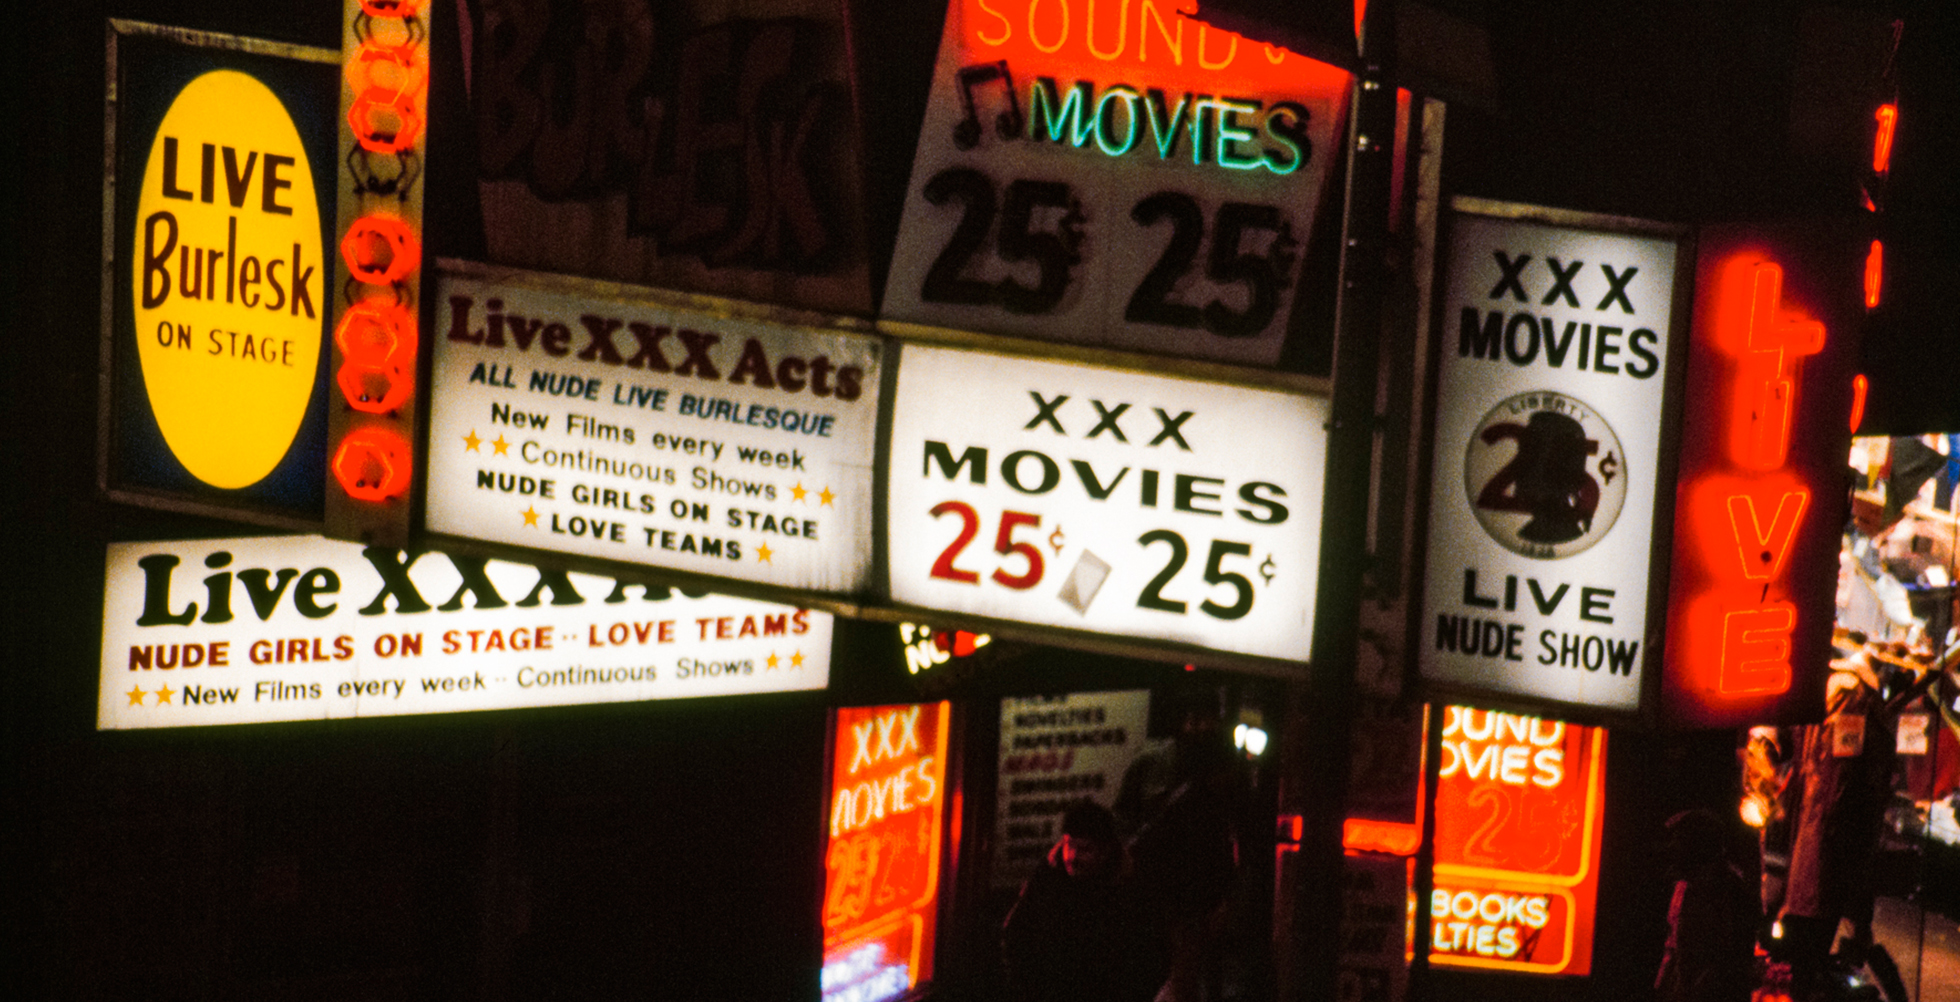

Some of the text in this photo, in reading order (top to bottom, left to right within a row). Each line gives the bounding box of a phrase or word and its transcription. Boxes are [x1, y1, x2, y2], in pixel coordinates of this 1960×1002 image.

[1029, 76, 1313, 174] MOVIES
[162, 137, 295, 216] LIVE
[141, 211, 316, 320] Burlesk
[1489, 249, 1640, 316] XXX
[157, 320, 295, 367] ON STAGE
[447, 295, 864, 401] Live XXX Acts
[1458, 306, 1660, 381] MOVIES
[469, 362, 835, 437] ALL NUDE LIVE BURLESQUE
[1023, 390, 1195, 453] XXX
[491, 402, 806, 471] New Films every week
[477, 470, 820, 539] NUDE GIRLS ON STAGE
[521, 441, 777, 501] Continuous Shows
[923, 439, 1289, 525] MOVIES
[1704, 258, 1824, 698] LIVE
[551, 514, 742, 560] LOVE TEAMS
[136, 551, 341, 628] Live
[1463, 569, 1617, 624] LIVE
[128, 609, 811, 671] NUDE GIRLS ON STAGE LOVE TEAMS
[1436, 613, 1639, 677] NUDE SHOW
[182, 656, 755, 707] New Films every week Continuous Shows
[850, 705, 920, 774] XXX
[1442, 706, 1565, 746] OUND
[1439, 740, 1563, 788] OVIES
[1432, 889, 1549, 929] BOOKS
[1433, 922, 1521, 957] LTIES
